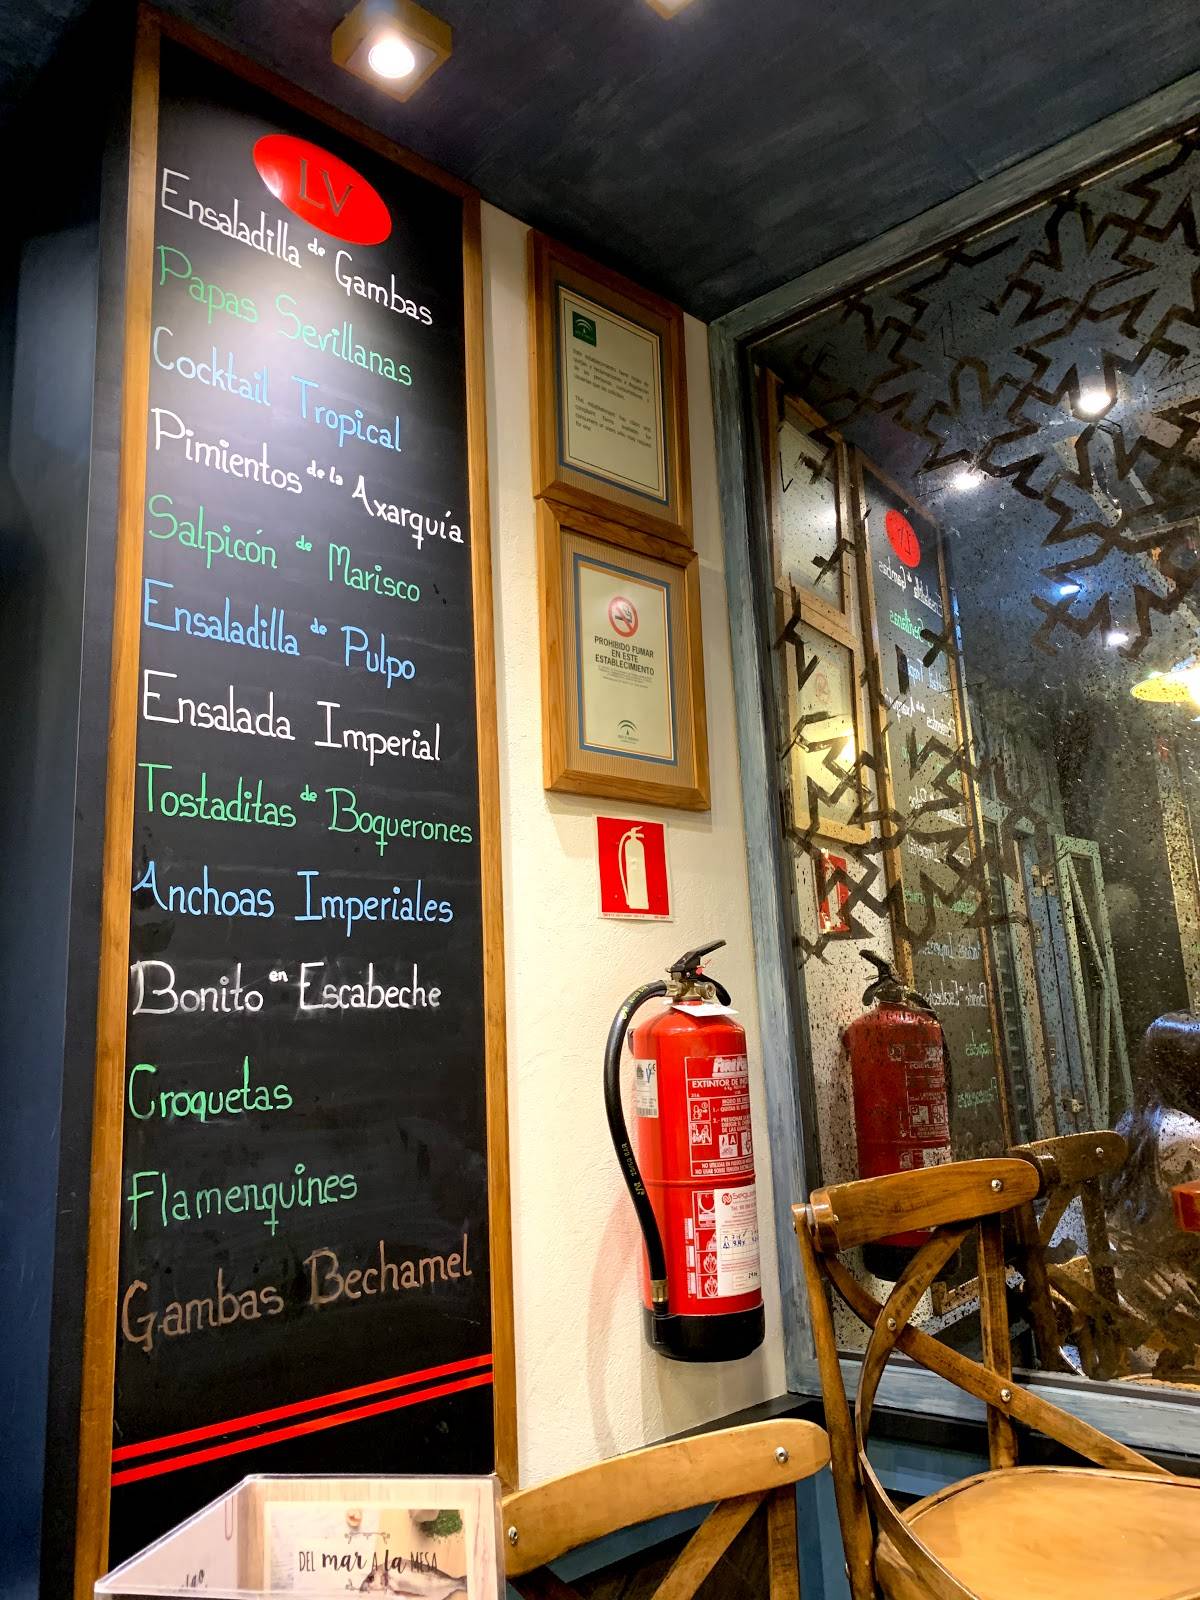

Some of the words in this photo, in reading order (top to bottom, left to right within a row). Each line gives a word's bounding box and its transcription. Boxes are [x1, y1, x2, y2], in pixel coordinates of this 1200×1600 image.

[298, 159, 353, 217] LV
[161, 168, 302, 268] Ensaladilla
[307, 238, 326, 257] de
[335, 250, 433, 325] Gambas
[157, 244, 259, 325] Papas
[275, 294, 413, 387] Sevillanas
[153, 326, 272, 406] Cocktail
[291, 375, 402, 452] Tropical
[151, 407, 303, 495] Pimientos
[306, 460, 325, 480] de
[329, 466, 344, 486] la
[352, 475, 465, 550] Axarquía
[148, 494, 278, 569] Salpicón
[295, 534, 313, 552] de
[328, 543, 421, 602] Marisco
[144, 578, 300, 656] Ensaladilla
[310, 617, 328, 636] de
[341, 625, 416, 688] Pulpo
[594, 635, 631, 652] PROHIBIDO
[632, 645, 655, 658] FUMAR
[594, 653, 655, 676] ESTABLECIMIENTO
[611, 649, 621, 658] EN
[622, 652, 639, 664] ESTE
[143, 669, 296, 741] Ensalada
[314, 700, 441, 766] Imperial
[138, 762, 297, 828] Tostaditas
[300, 784, 318, 802] de
[325, 787, 473, 857] Boquerones
[132, 861, 275, 918] Anchoas
[294, 870, 454, 937] Imperiales
[130, 960, 264, 1015] Bonito
[268, 969, 289, 983] en
[299, 962, 442, 1011] Escabeche
[128, 1055, 293, 1122] Croquetas
[692, 1078, 730, 1089] EXTINTOR
[127, 1163, 358, 1236] Flamenquines
[121, 1266, 285, 1353] Gambas
[302, 1232, 474, 1308] Bechamel
[298, 1551, 316, 1573] DEL
[321, 1551, 368, 1573] mar
[371, 1551, 379, 1573] A
[383, 1549, 407, 1574] la
[409, 1551, 439, 1573] MESA
